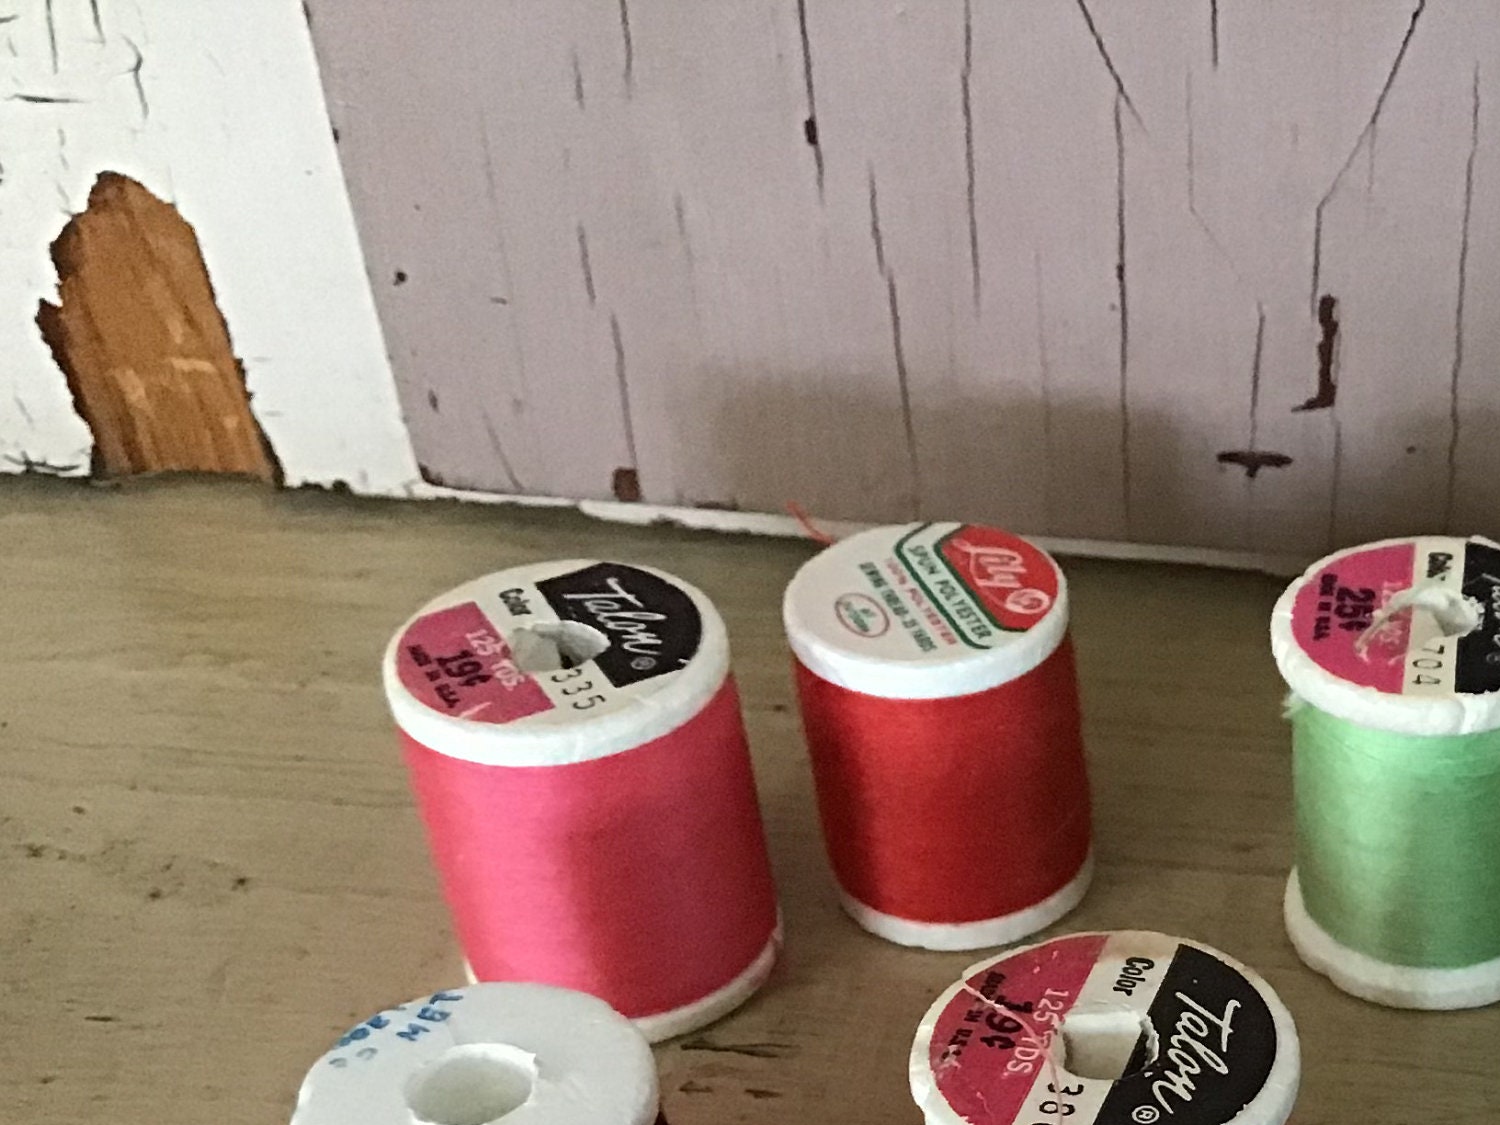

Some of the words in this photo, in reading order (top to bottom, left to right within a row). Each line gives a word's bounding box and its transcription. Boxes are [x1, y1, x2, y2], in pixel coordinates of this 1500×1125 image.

[953, 538, 1028, 590] Lily
[563, 577, 667, 655] Talon
[908, 545, 936, 576] SPUN
[935, 579, 992, 640] POLYESTER
[551, 668, 605, 709] 335
[1113, 956, 1154, 996] Color
[1033, 987, 1069, 1023] 125
[1152, 991, 1242, 1115] Talon
